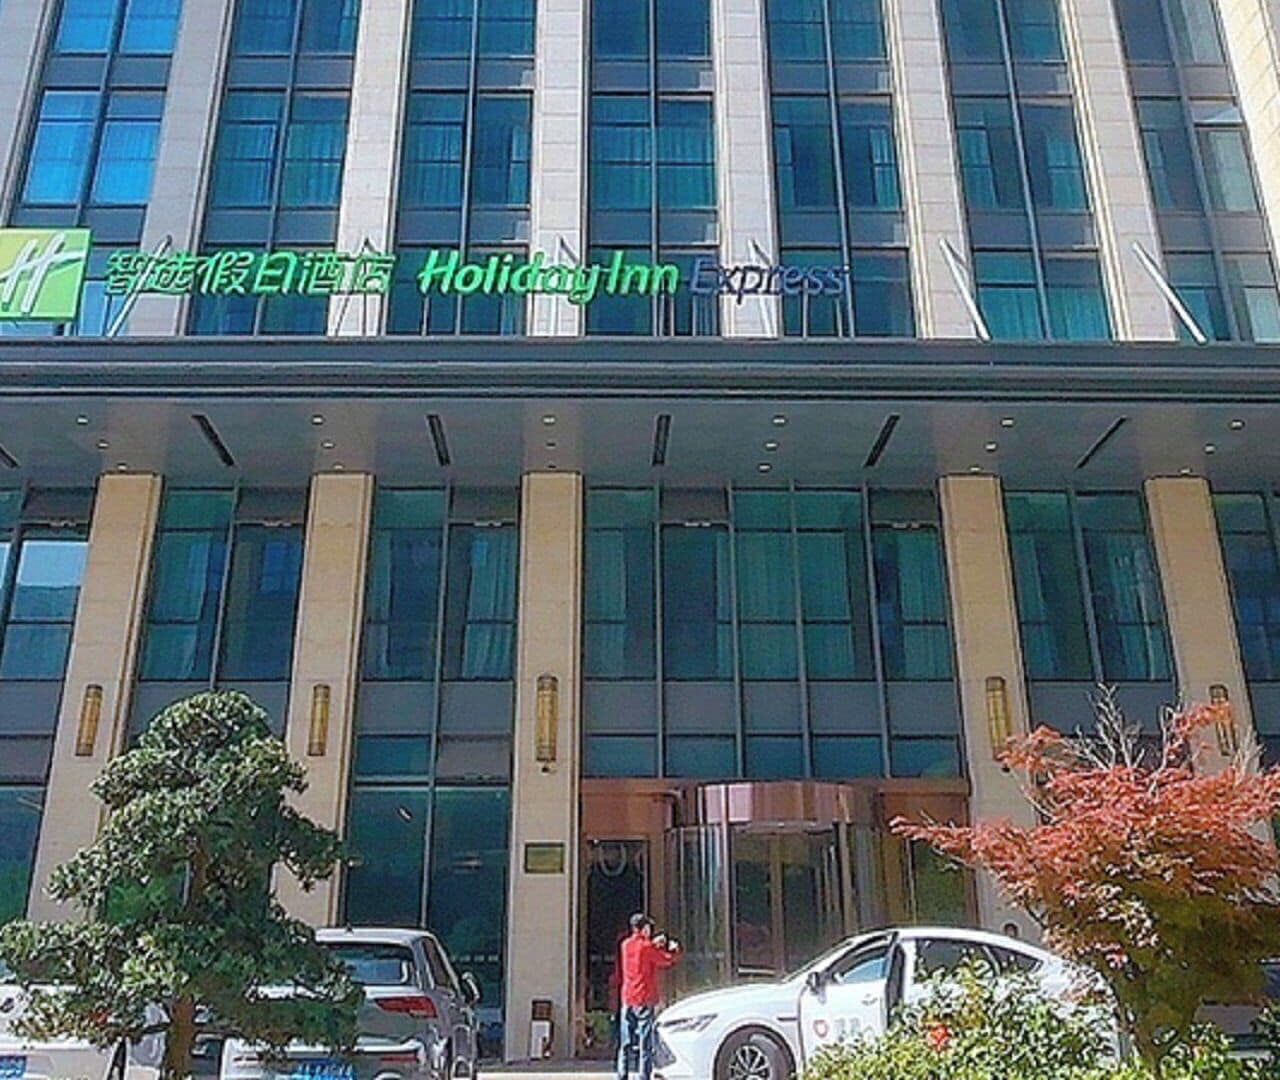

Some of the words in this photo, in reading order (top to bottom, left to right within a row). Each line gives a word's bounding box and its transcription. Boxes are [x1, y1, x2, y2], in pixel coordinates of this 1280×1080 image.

[104, 250, 396, 294] 智选假日酒店
[417, 248, 600, 304] Holiday
[605, 250, 680, 295] Inn
[688, 255, 849, 306] Express
